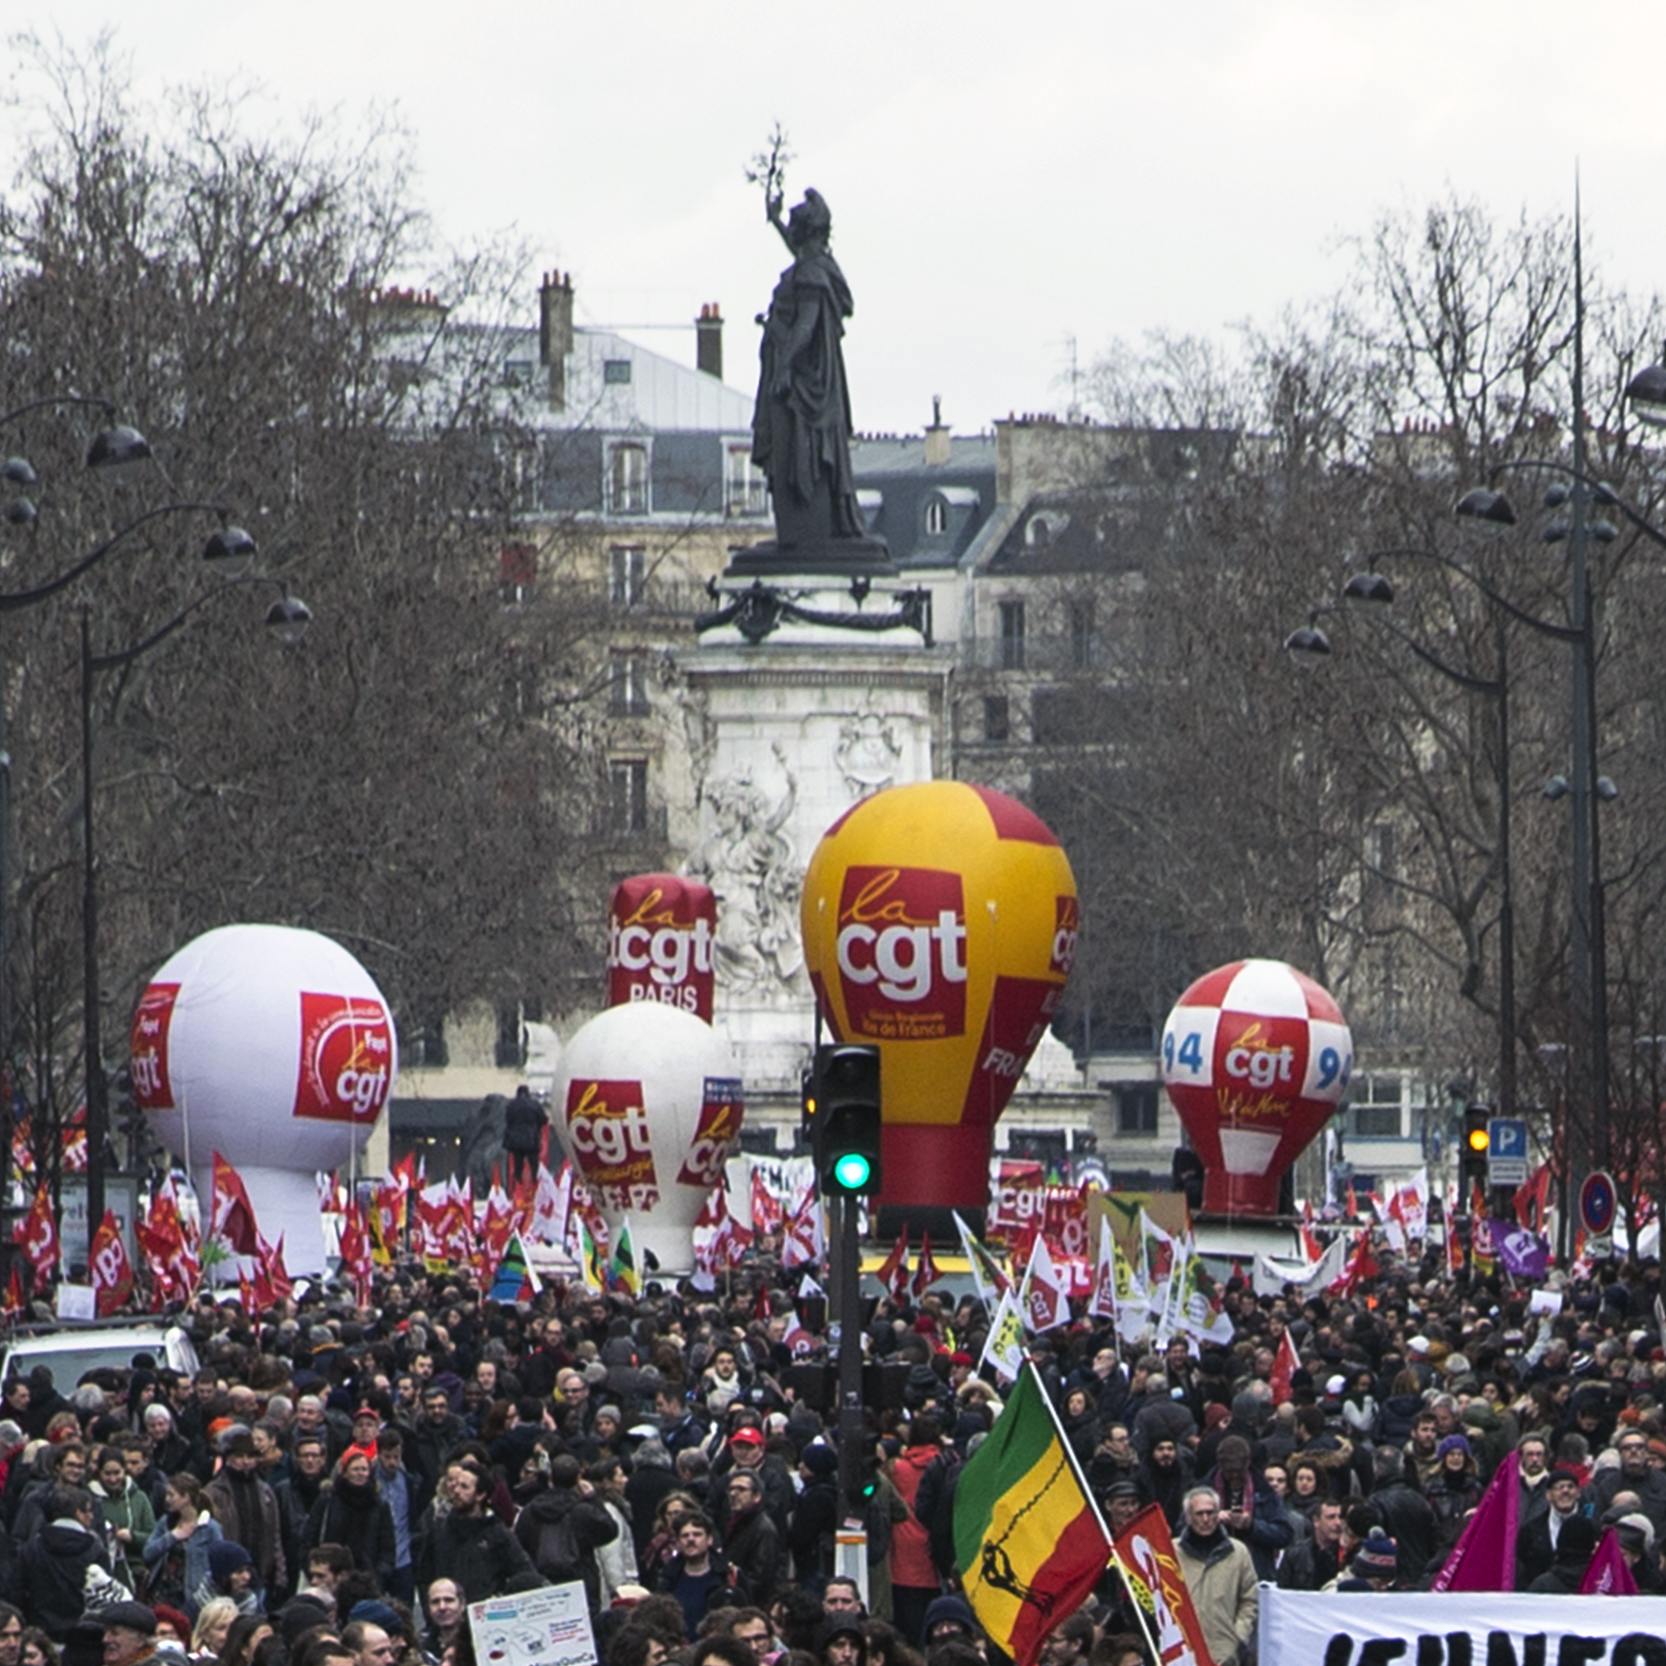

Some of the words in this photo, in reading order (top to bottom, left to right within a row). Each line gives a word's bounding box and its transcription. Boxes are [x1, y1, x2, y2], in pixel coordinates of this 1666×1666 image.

[619, 918, 710, 984] cgt
[837, 911, 966, 1001] cgt
[1052, 929, 1078, 973] cg
[630, 983, 699, 1013] PARIS
[1162, 1031, 1203, 1075] 94
[1225, 1047, 1294, 1088] cgt
[336, 1063, 387, 1114] cgt
[568, 1106, 652, 1164] cgt
[686, 1138, 733, 1183] cg
